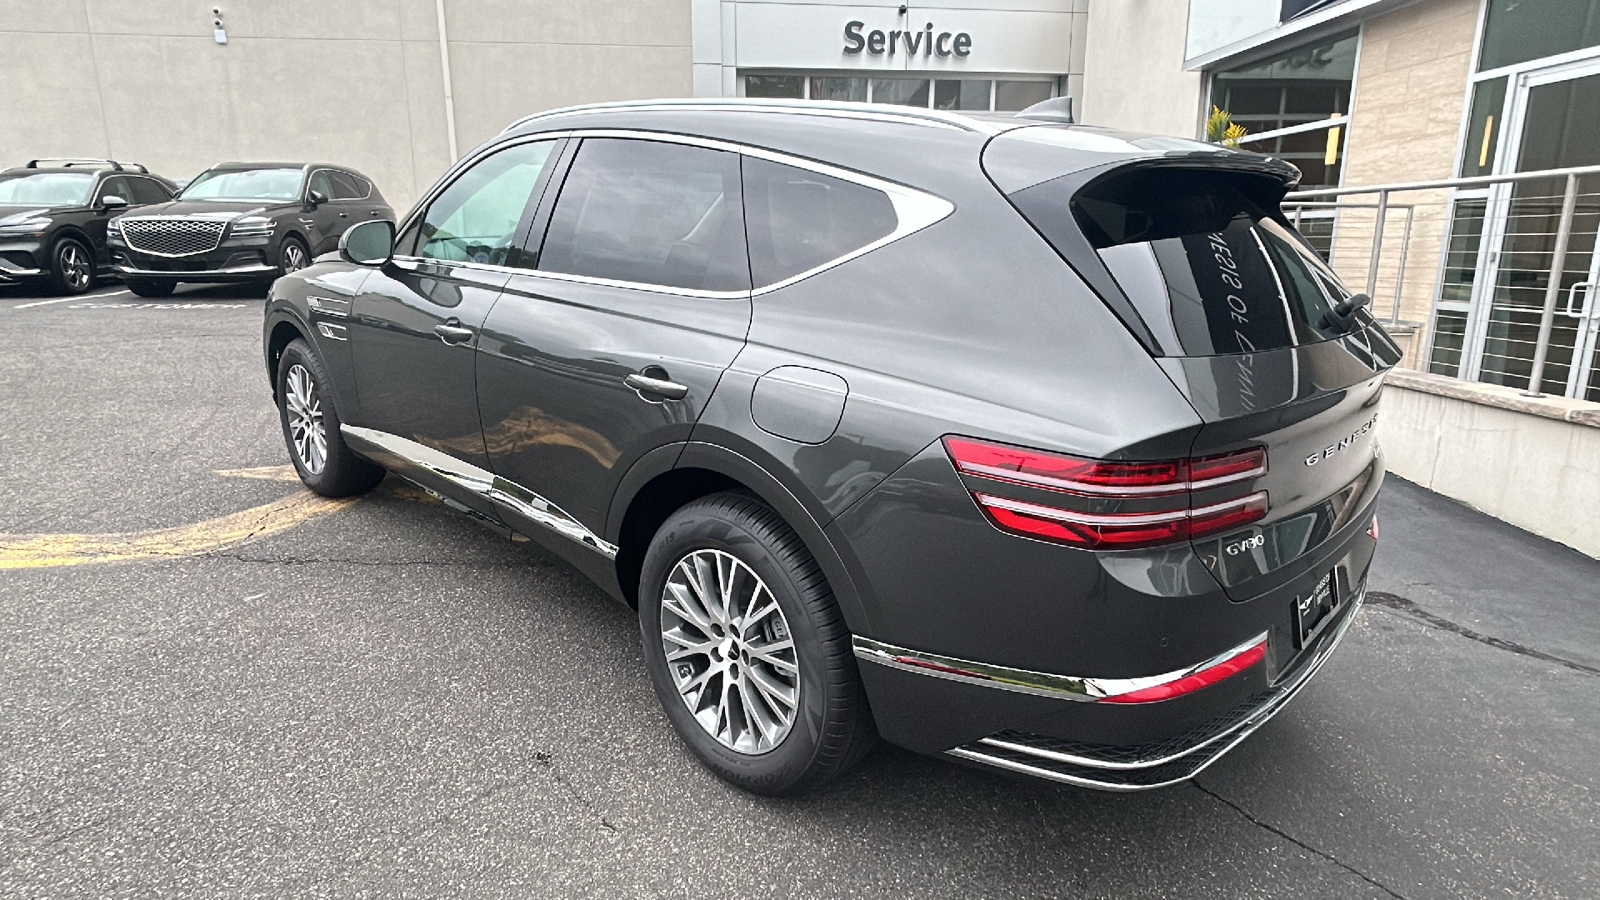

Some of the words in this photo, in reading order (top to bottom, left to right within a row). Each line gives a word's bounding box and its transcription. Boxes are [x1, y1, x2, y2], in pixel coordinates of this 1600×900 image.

[842, 20, 972, 57] Service
[1304, 412, 1378, 466] GENESIS
[1226, 534, 1265, 556] GV80
